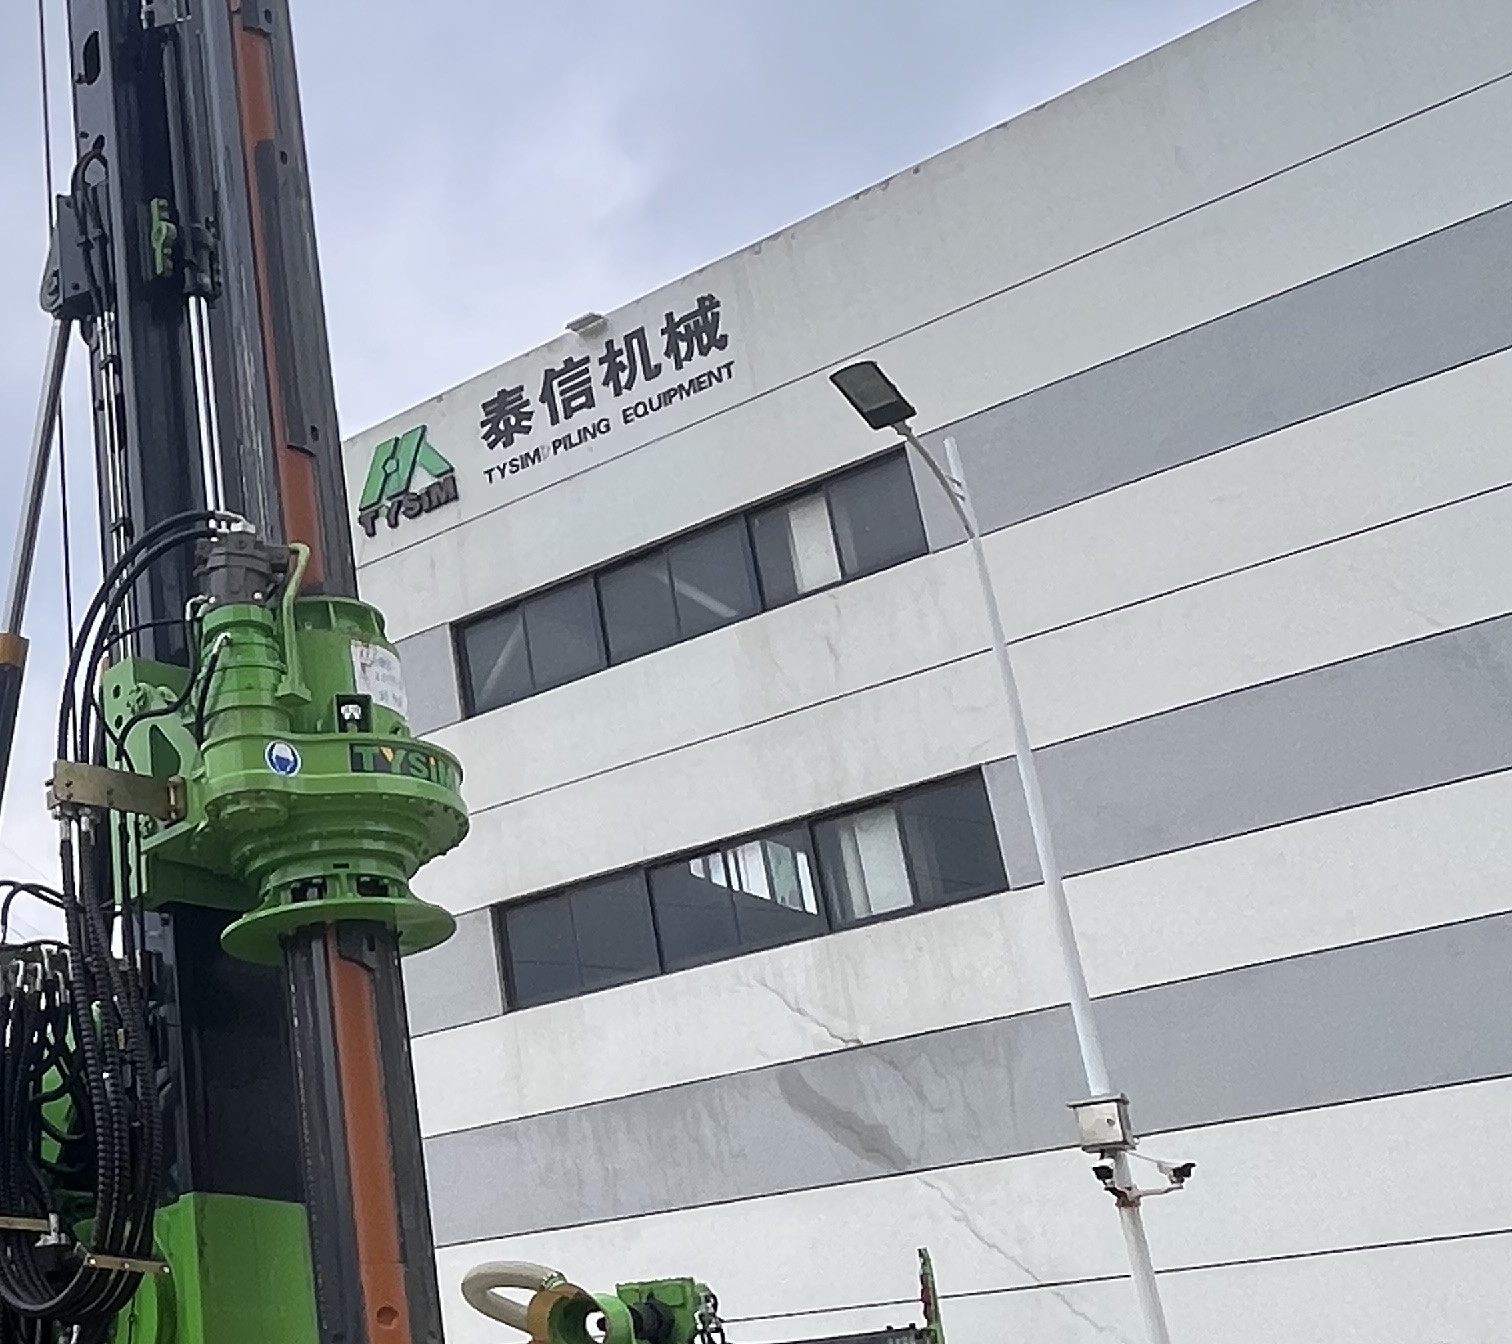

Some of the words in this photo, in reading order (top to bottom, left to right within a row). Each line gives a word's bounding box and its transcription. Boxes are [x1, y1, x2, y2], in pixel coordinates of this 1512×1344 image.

[480, 293, 729, 450] 泰信机械
[484, 444, 543, 485] TYSIM
[552, 417, 611, 457] PILING
[622, 360, 736, 424] EQUIPMENT
